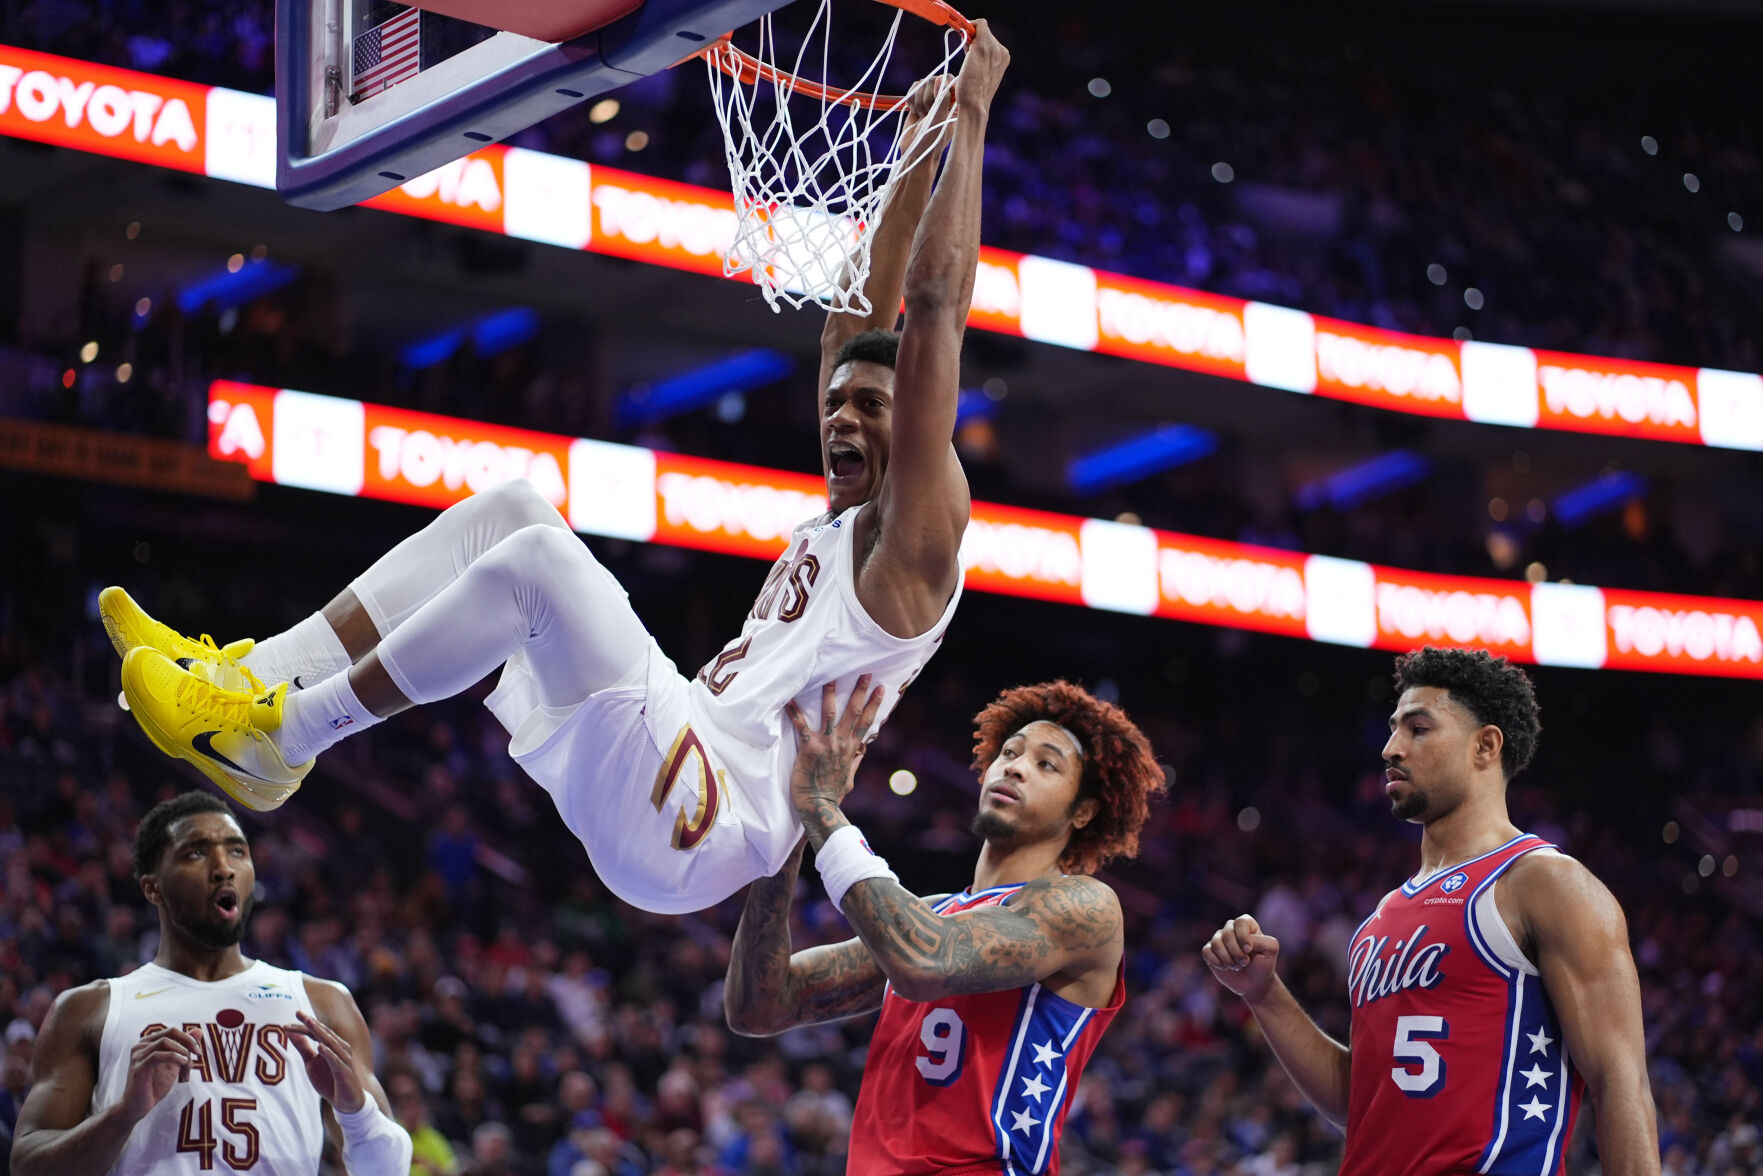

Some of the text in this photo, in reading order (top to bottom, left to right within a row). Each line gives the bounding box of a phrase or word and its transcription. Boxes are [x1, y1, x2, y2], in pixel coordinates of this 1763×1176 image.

[0, 64, 198, 152] TOYOTA
[370, 425, 567, 508] TOYOTA
[1608, 605, 1763, 663] TOYOTA
[1423, 896, 1464, 905] crypto.com
[248, 991, 293, 1000] CLIFFS
[1348, 925, 1452, 1009] Phila
[915, 1007, 967, 1087] 9
[1391, 1015, 1449, 1099] 5
[176, 1096, 260, 1170] 45
